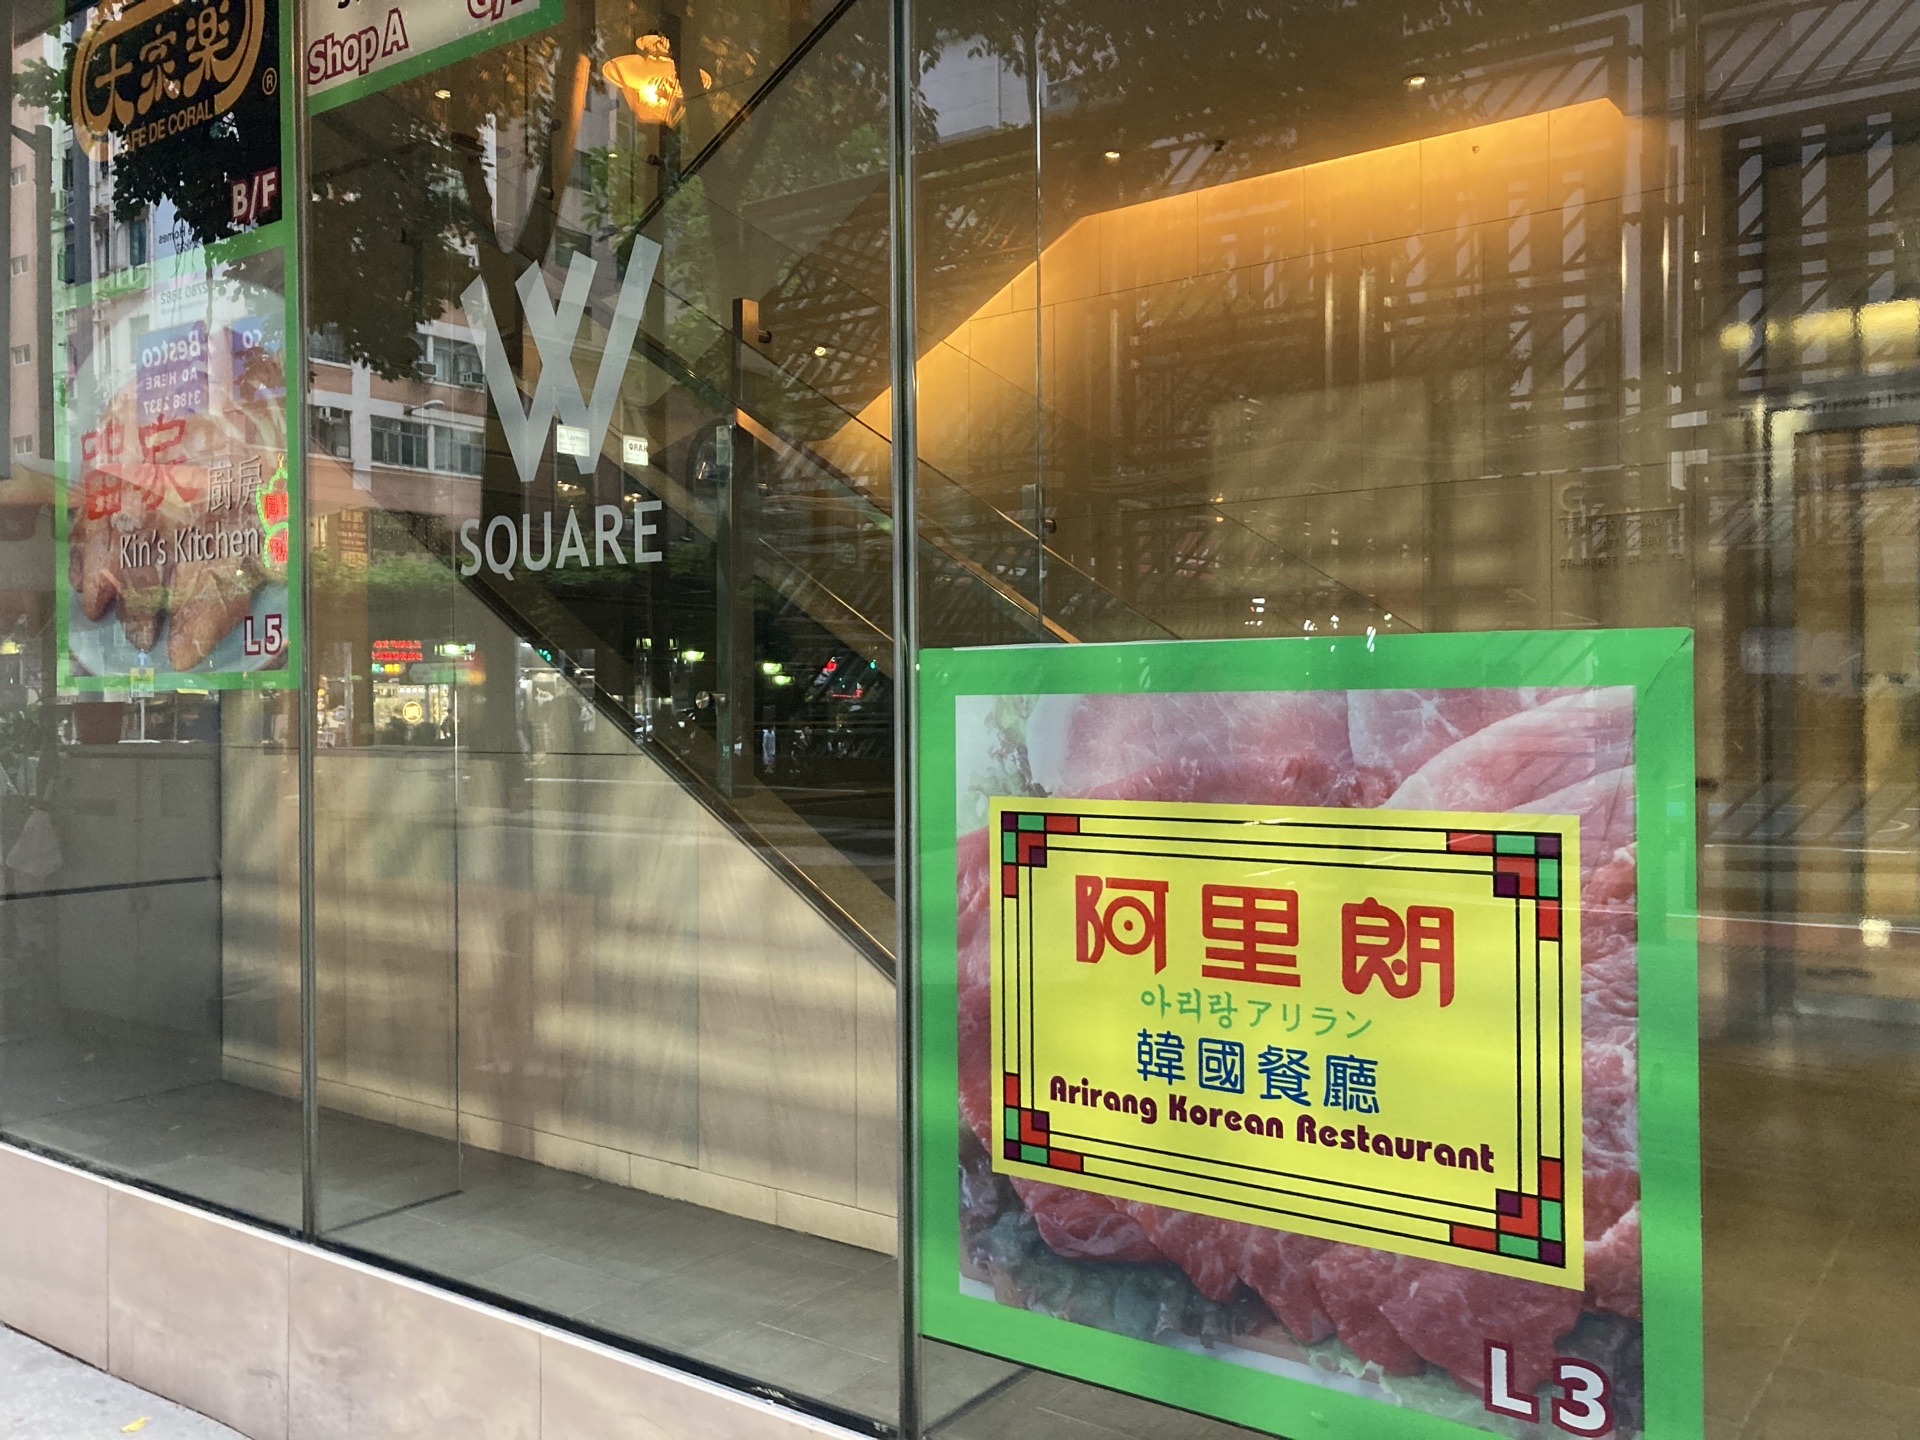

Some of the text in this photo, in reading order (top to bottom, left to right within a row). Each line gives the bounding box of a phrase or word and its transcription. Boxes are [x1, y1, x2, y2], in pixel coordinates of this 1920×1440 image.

[307, 8, 409, 85] Shop A
[149, 119, 167, 144] DE
[168, 98, 215, 133] CORAL
[231, 168, 280, 225] B/F
[119, 531, 168, 569] Kin's
[174, 521, 261, 563] Kitchen
[460, 500, 663, 581] SQUARE
[1075, 874, 1455, 1009] 阿里朗
[1140, 983, 1373, 1039] 아리랑 アリラン
[1136, 1028, 1380, 1114] 韓國餐廳
[1050, 1075, 1495, 1173] Arirang Korean Restaurant
